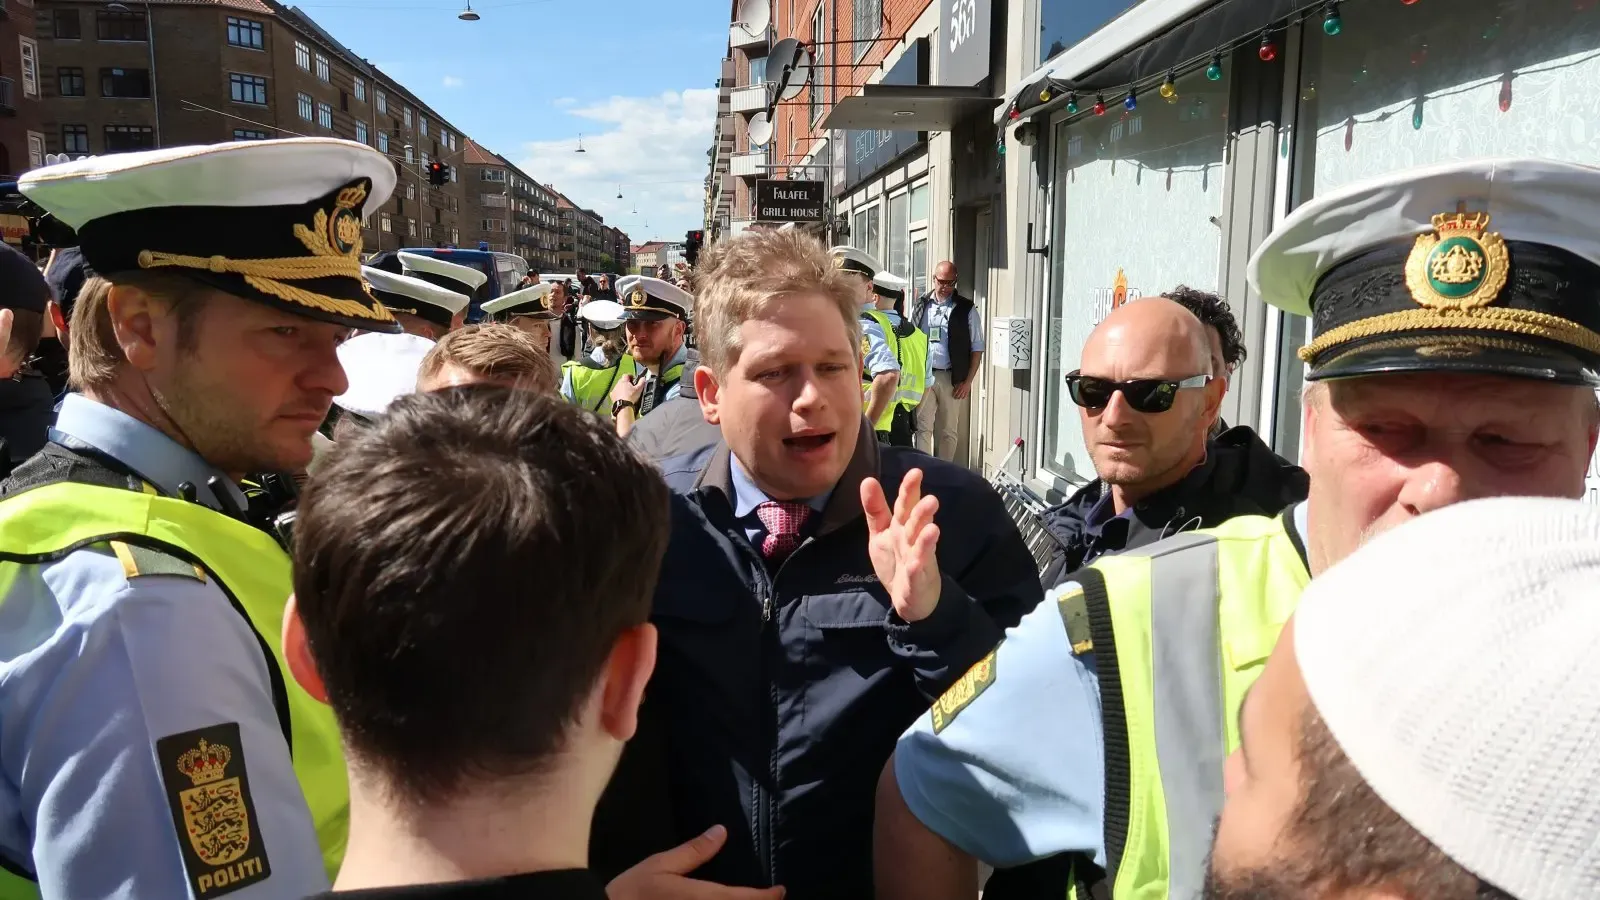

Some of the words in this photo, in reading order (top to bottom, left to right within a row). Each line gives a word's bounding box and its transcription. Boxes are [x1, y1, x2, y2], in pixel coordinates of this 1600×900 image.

[762, 207, 787, 217] GRILL
[790, 208, 820, 217] HOUSE
[198, 856, 263, 893] POLITI
